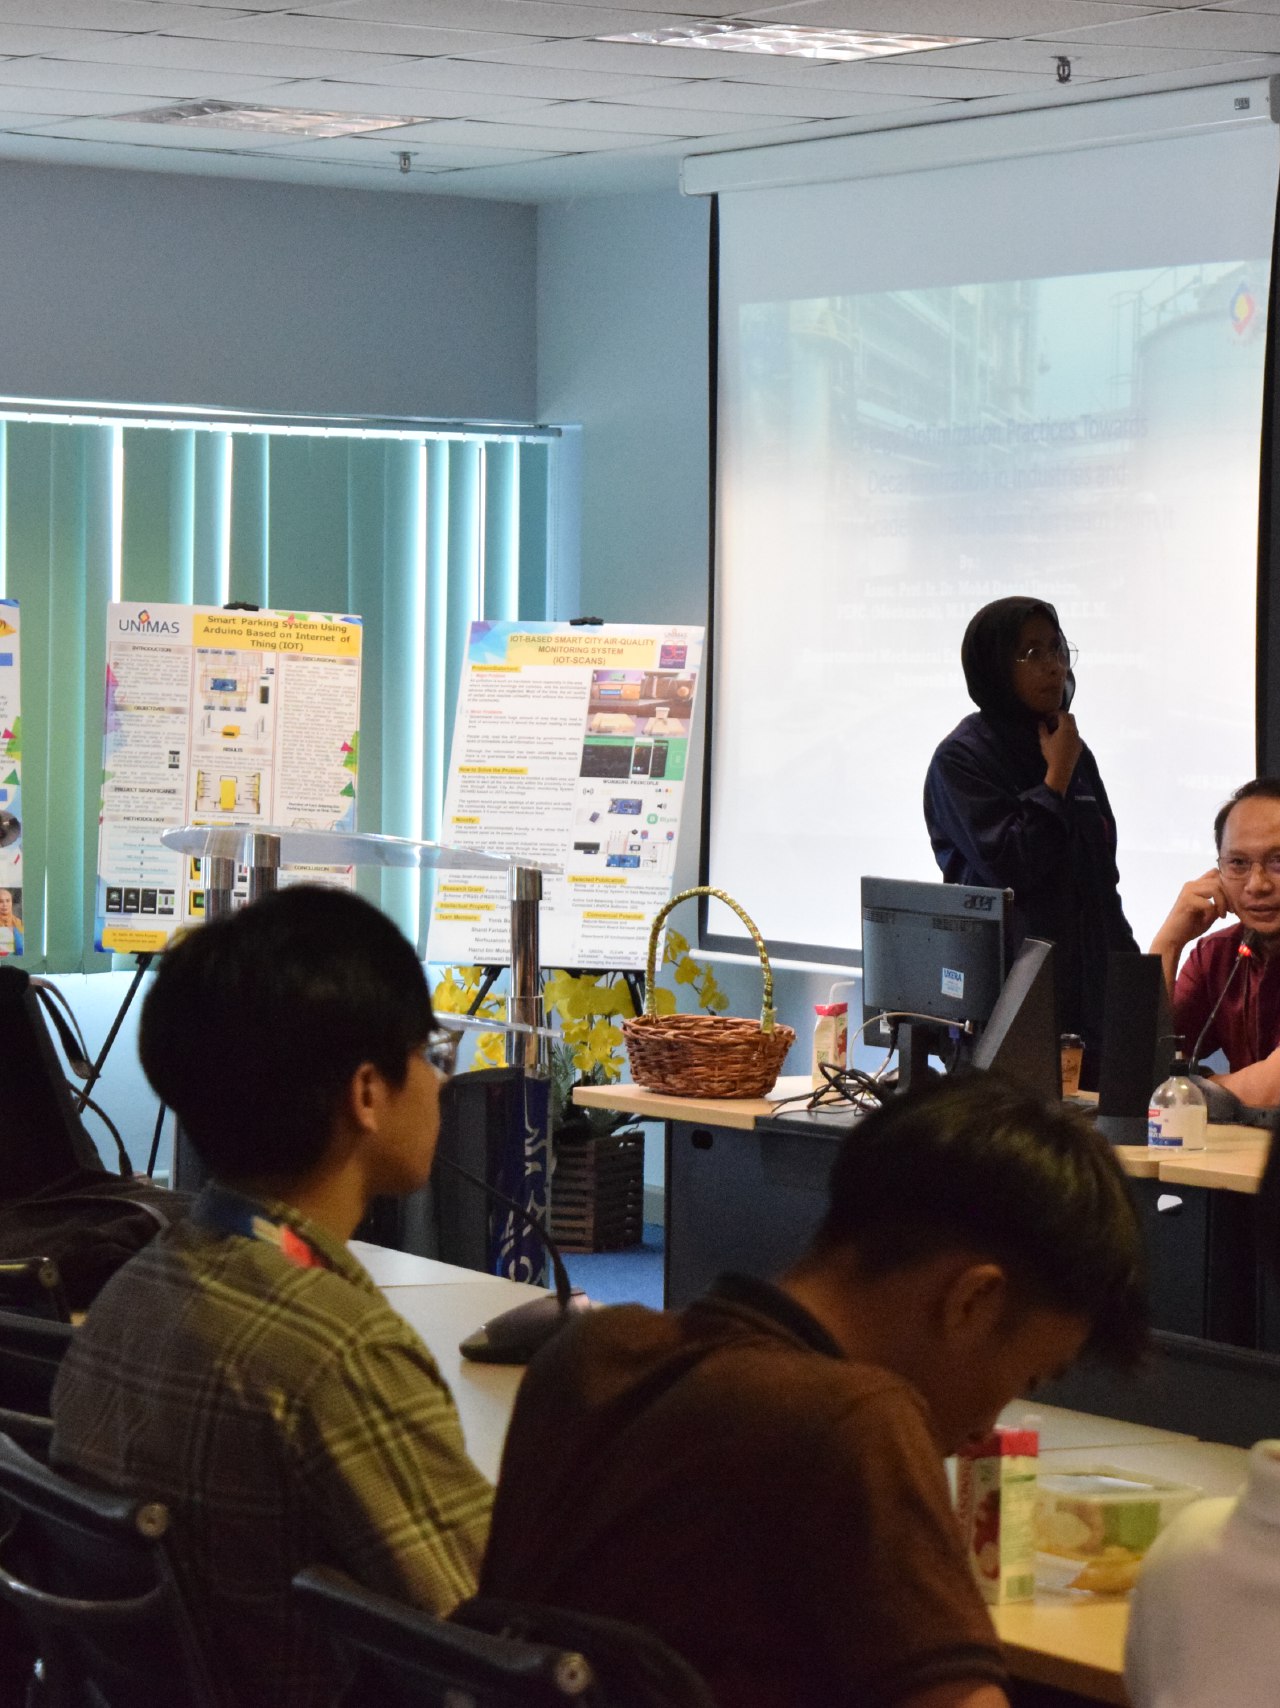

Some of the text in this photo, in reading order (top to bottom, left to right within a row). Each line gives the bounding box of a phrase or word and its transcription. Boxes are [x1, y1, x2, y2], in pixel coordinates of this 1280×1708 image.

[1006, 416, 1077, 443] Practices
[1080, 411, 1148, 439] Towards
[207, 616, 348, 634] Smart Parking System Using
[203, 626, 243, 636] Arduino
[246, 629, 276, 638] Based
[295, 632, 335, 643] Internet
[340, 634, 351, 643] of
[510, 636, 655, 646] IOT-BASED SMART CITY AIR-QUALITY
[251, 640, 304, 652] Thing (IOT)
[538, 646, 624, 655] MONITORING SYSTEM
[553, 656, 606, 665] (IOT-SCANS)
[964, 893, 997, 912] acer
